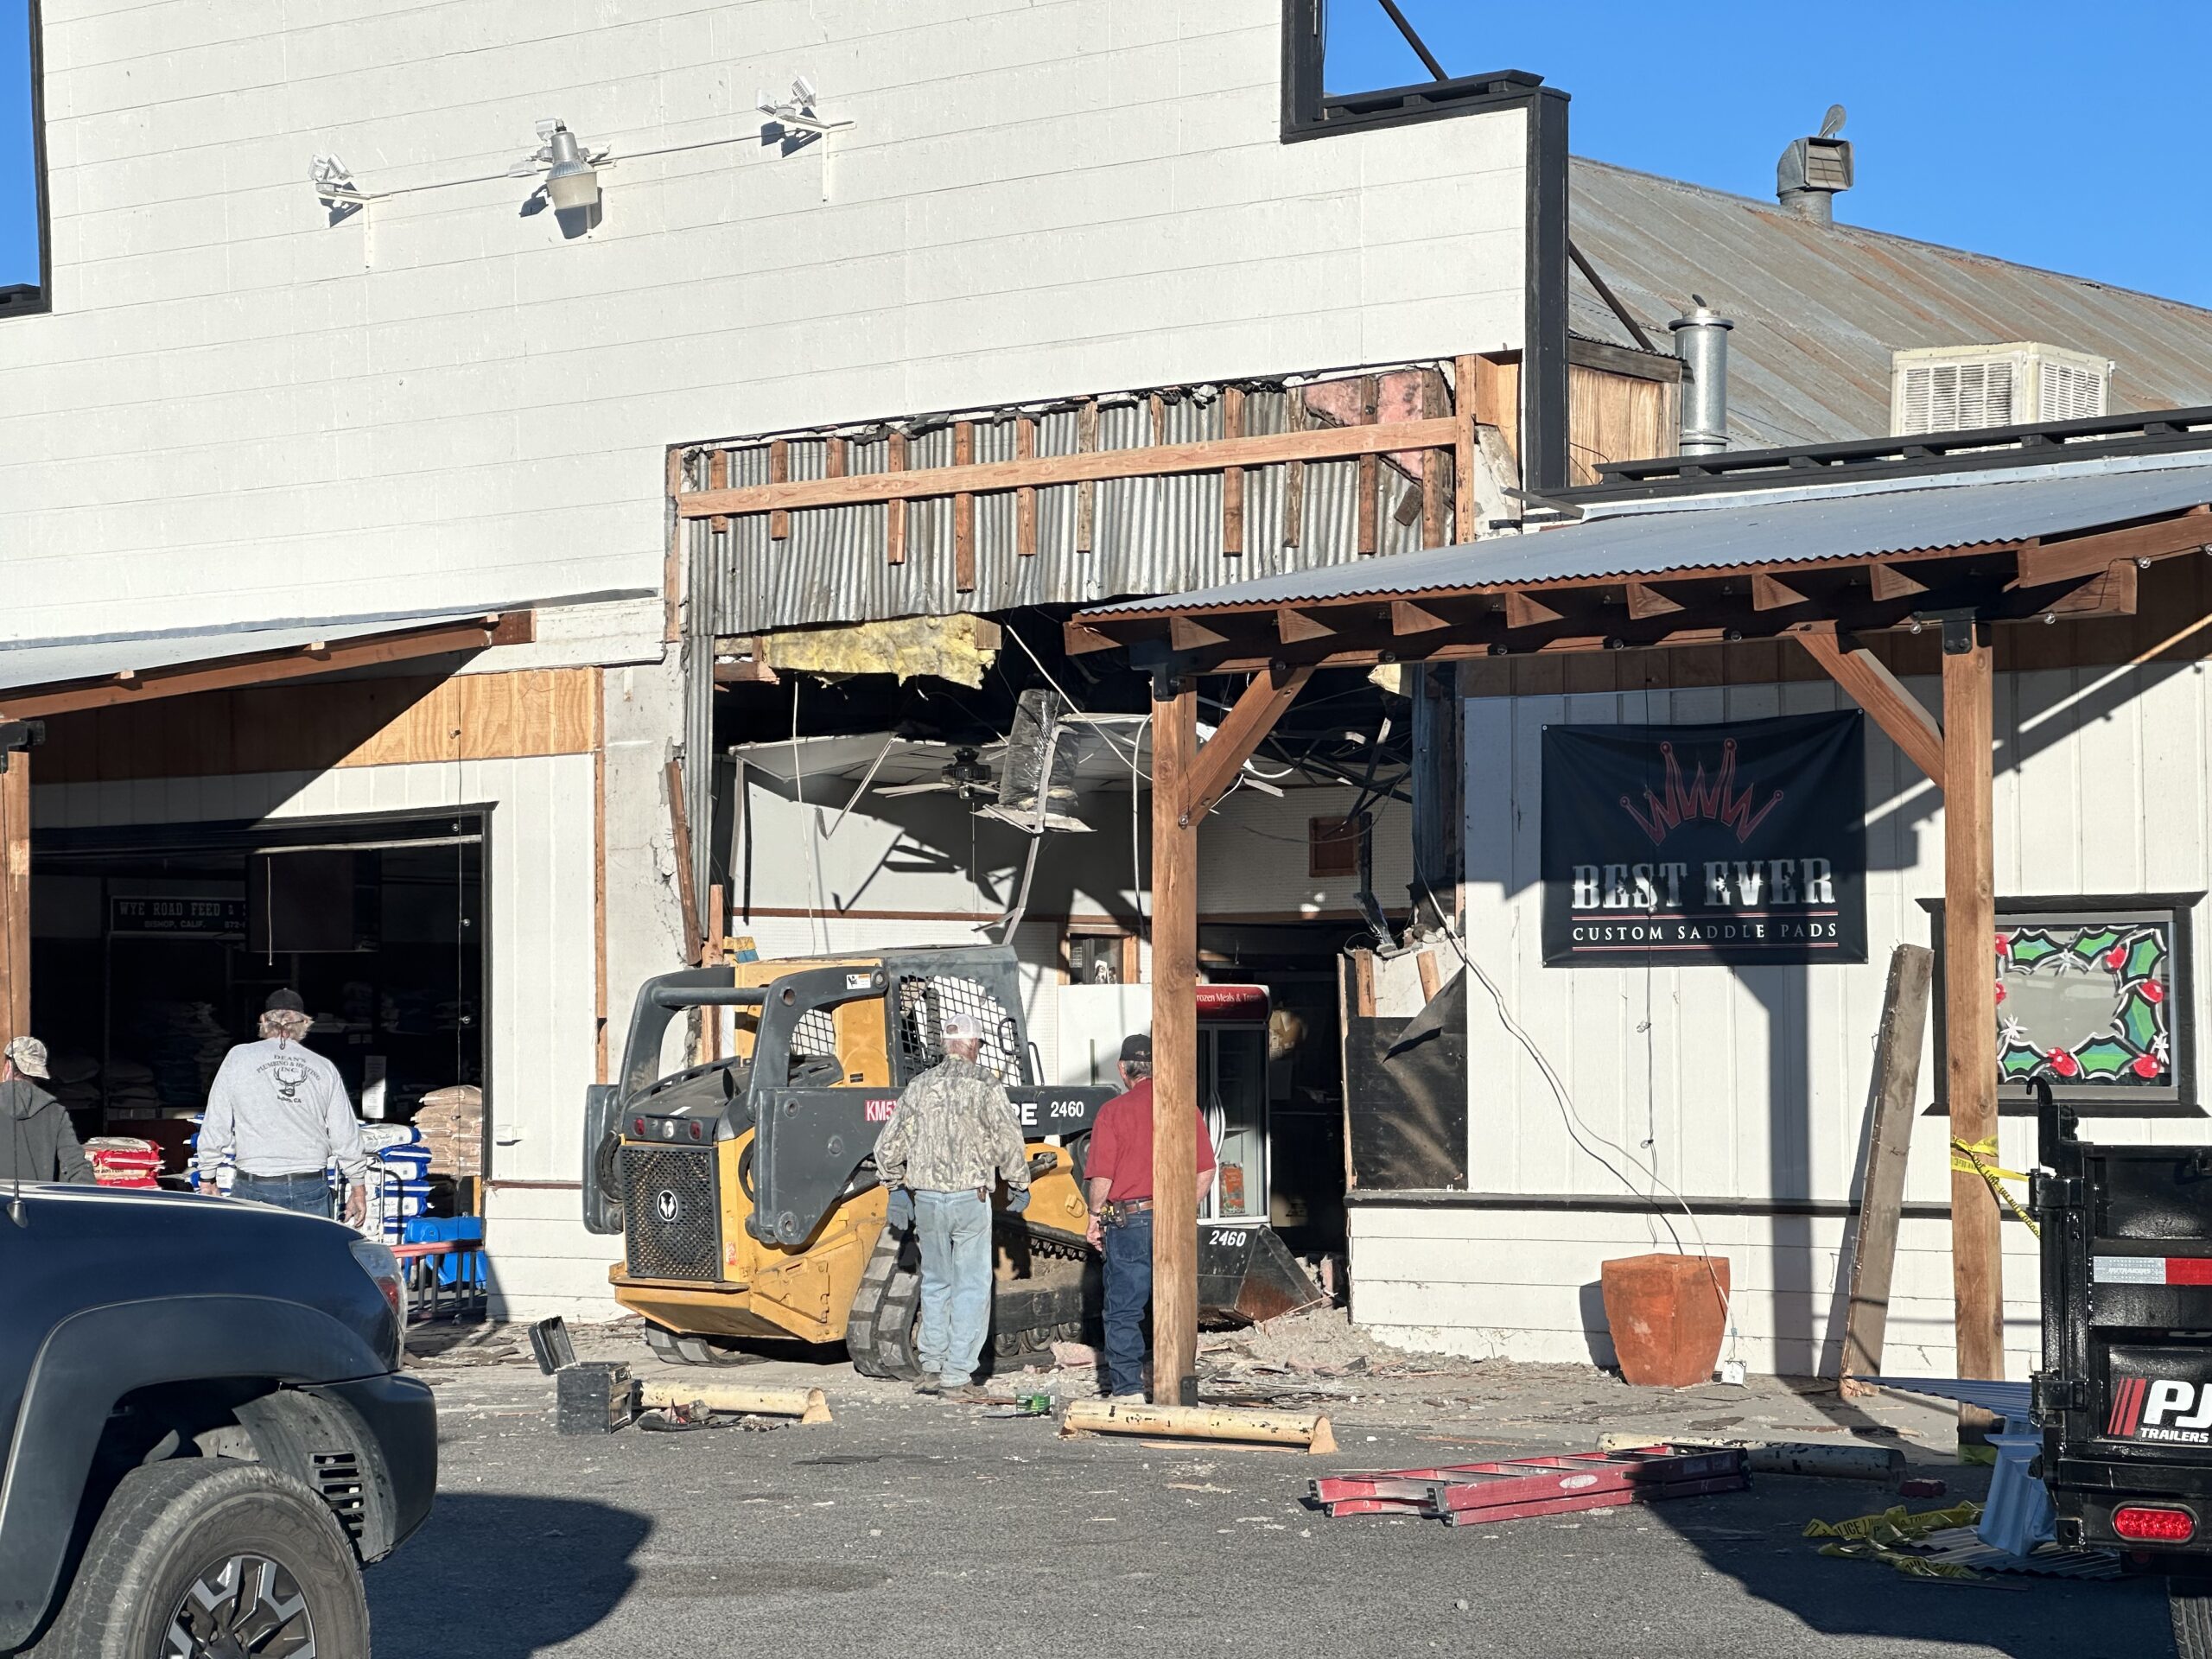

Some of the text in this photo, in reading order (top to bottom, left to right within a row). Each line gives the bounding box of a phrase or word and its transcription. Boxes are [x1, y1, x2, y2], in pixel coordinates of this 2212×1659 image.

[1572, 858, 1836, 909] BEST EVER
[119, 901, 145, 916] WYE
[153, 902, 183, 916] ROAD
[190, 902, 221, 917] FEED
[228, 905, 235, 915] &
[1572, 923, 1836, 941] CUSTOM SADDLE PADS
[1196, 994, 1215, 1002] rozen
[1216, 992, 1235, 1002] Meals
[1236, 993, 1242, 1002] &
[256, 1060, 289, 1073] PLUMBING
[296, 1062, 321, 1081] HEATING
[1050, 1101, 1084, 1118] 2460
[1208, 1230, 1247, 1247] 2460
[2143, 1379, 2212, 1428] PJ
[2140, 1427, 2209, 1443] TRAILERS
